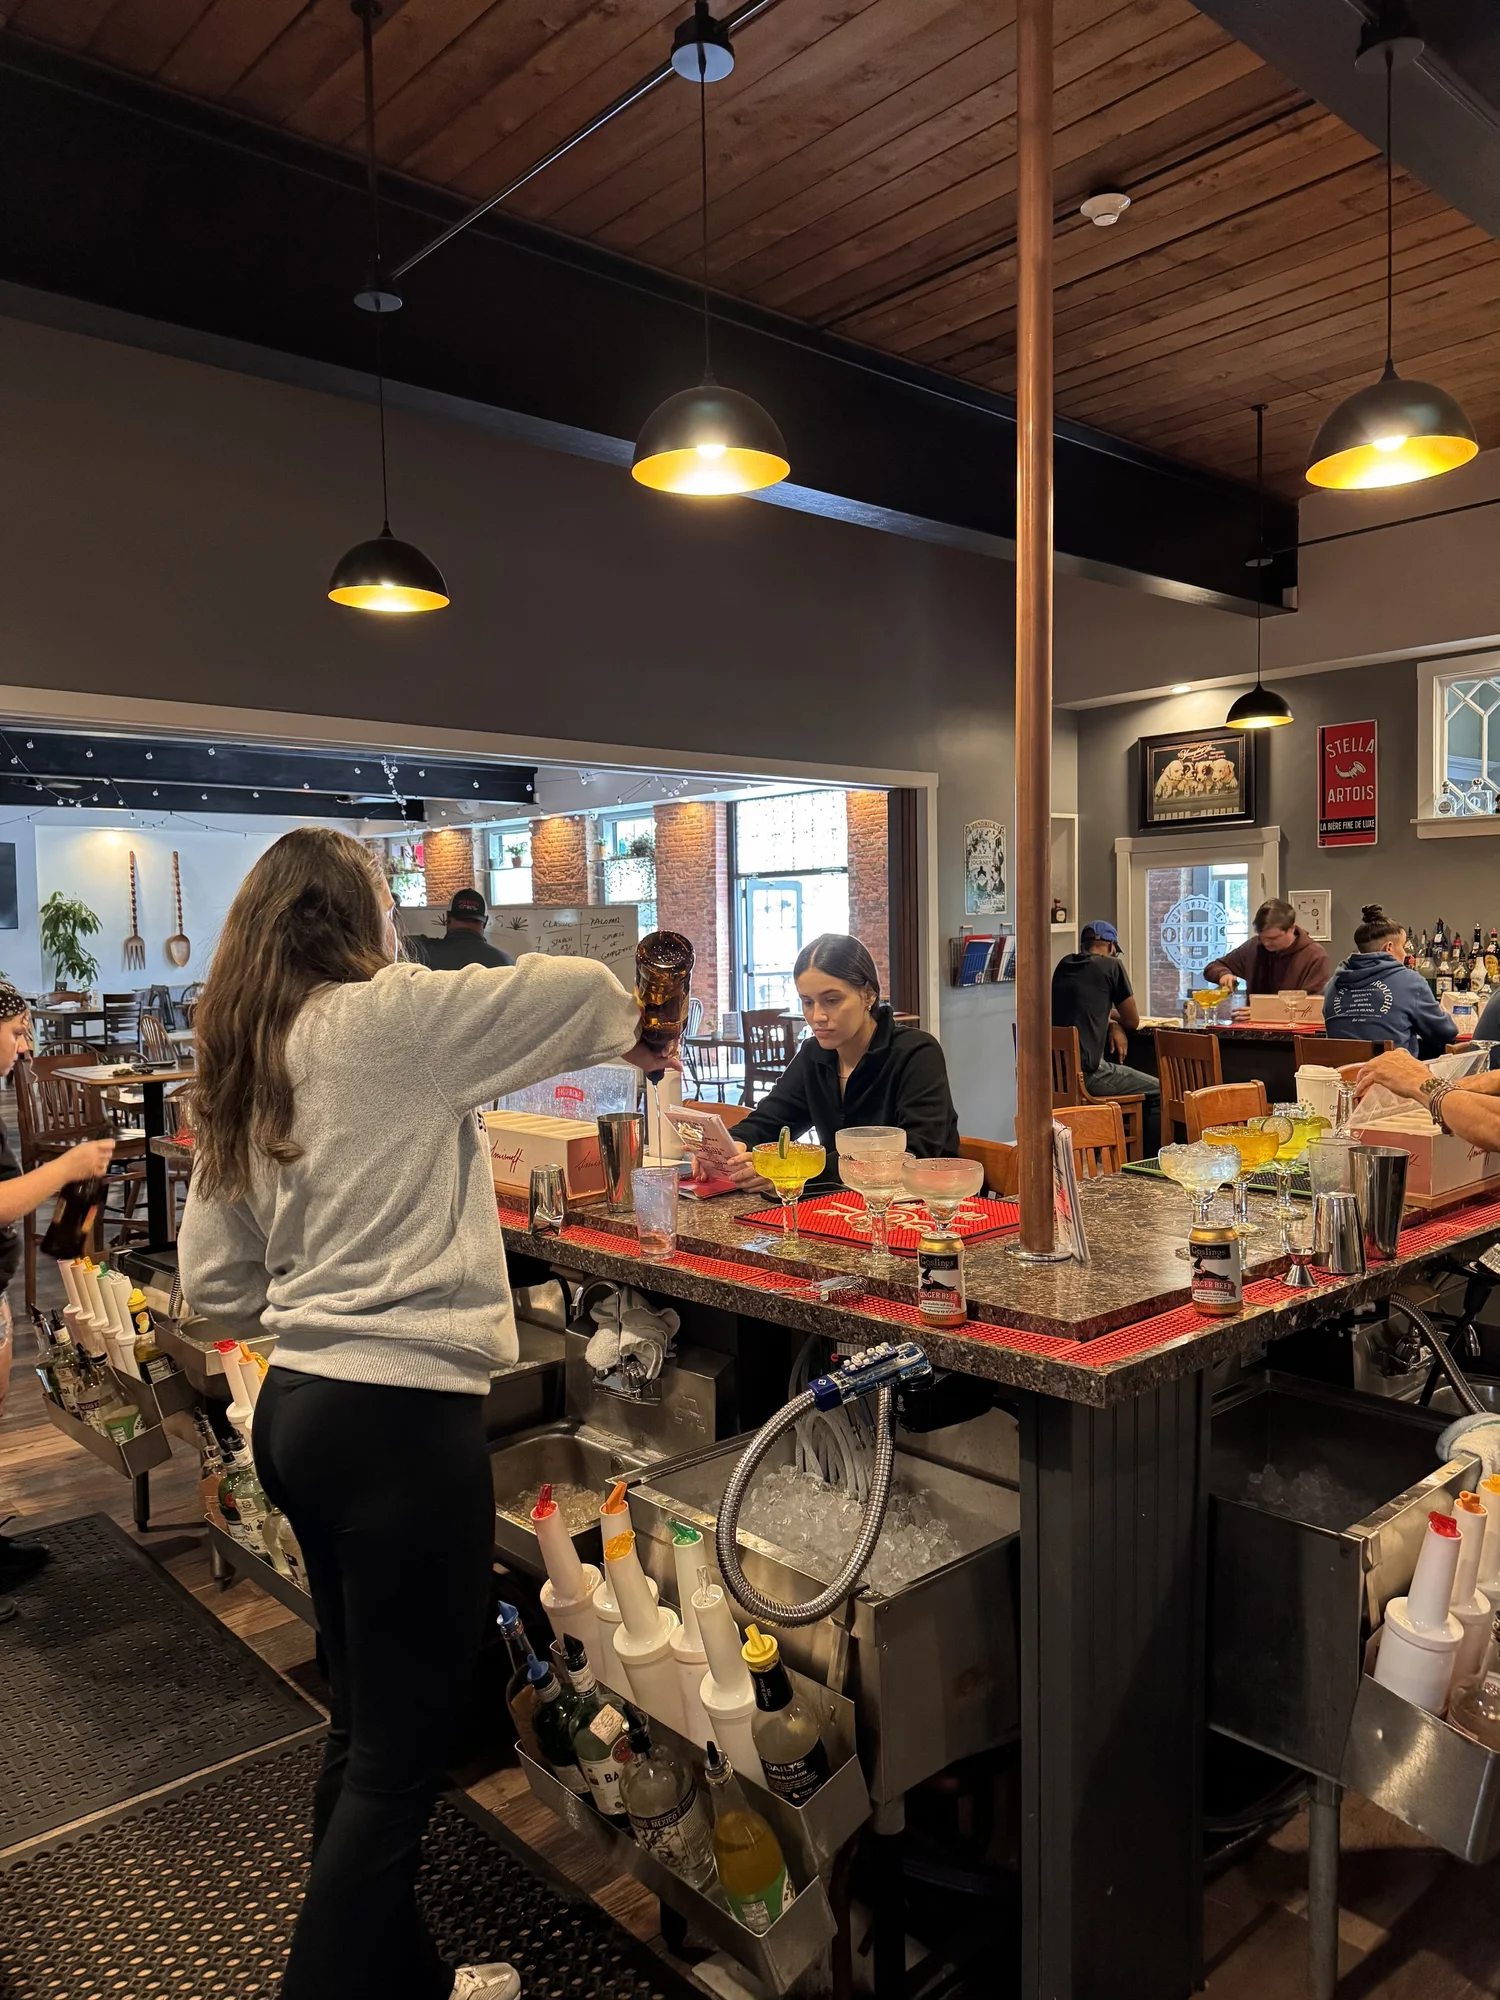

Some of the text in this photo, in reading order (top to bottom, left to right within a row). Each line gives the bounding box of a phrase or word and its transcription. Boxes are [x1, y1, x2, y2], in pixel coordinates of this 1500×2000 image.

[1326, 737, 1375, 758] STELLA
[1328, 786, 1374, 803] ARTOIS
[1320, 819, 1374, 831] LA BIÈRE FINE DE LUXE
[1370, 980, 1393, 1014] ROUGHS
[490, 1140, 524, 1173] Smirnoff
[1192, 1246, 1226, 1258] Goslings
[921, 1256, 954, 1269] Goslings
[766, 1760, 806, 1772] DAILY'S
[651, 1814, 677, 1828] MEXICO
